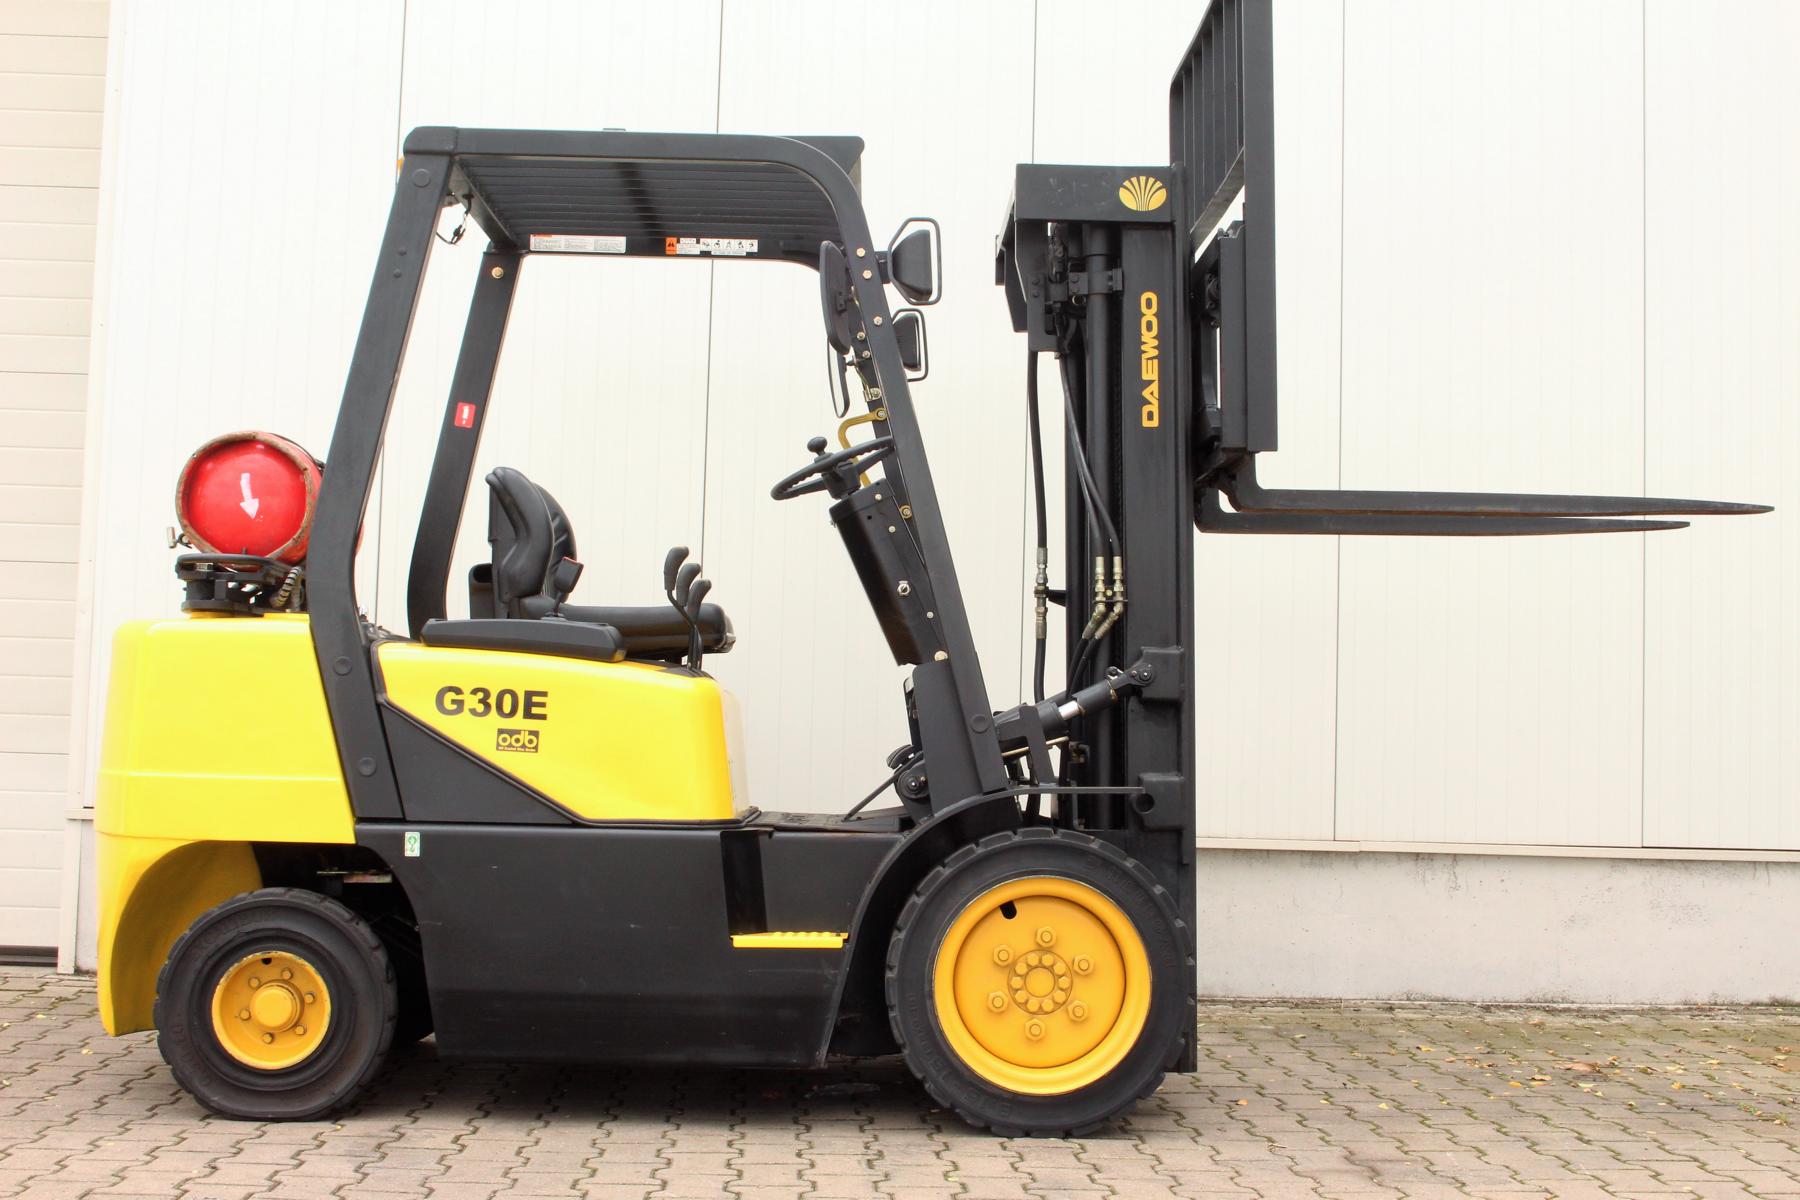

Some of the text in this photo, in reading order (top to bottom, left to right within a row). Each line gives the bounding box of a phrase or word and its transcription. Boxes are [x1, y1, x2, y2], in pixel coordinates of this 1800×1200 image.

[1140, 291, 1159, 428] DAEWOO
[435, 685, 549, 721] G30E
[498, 730, 538, 748] odb
